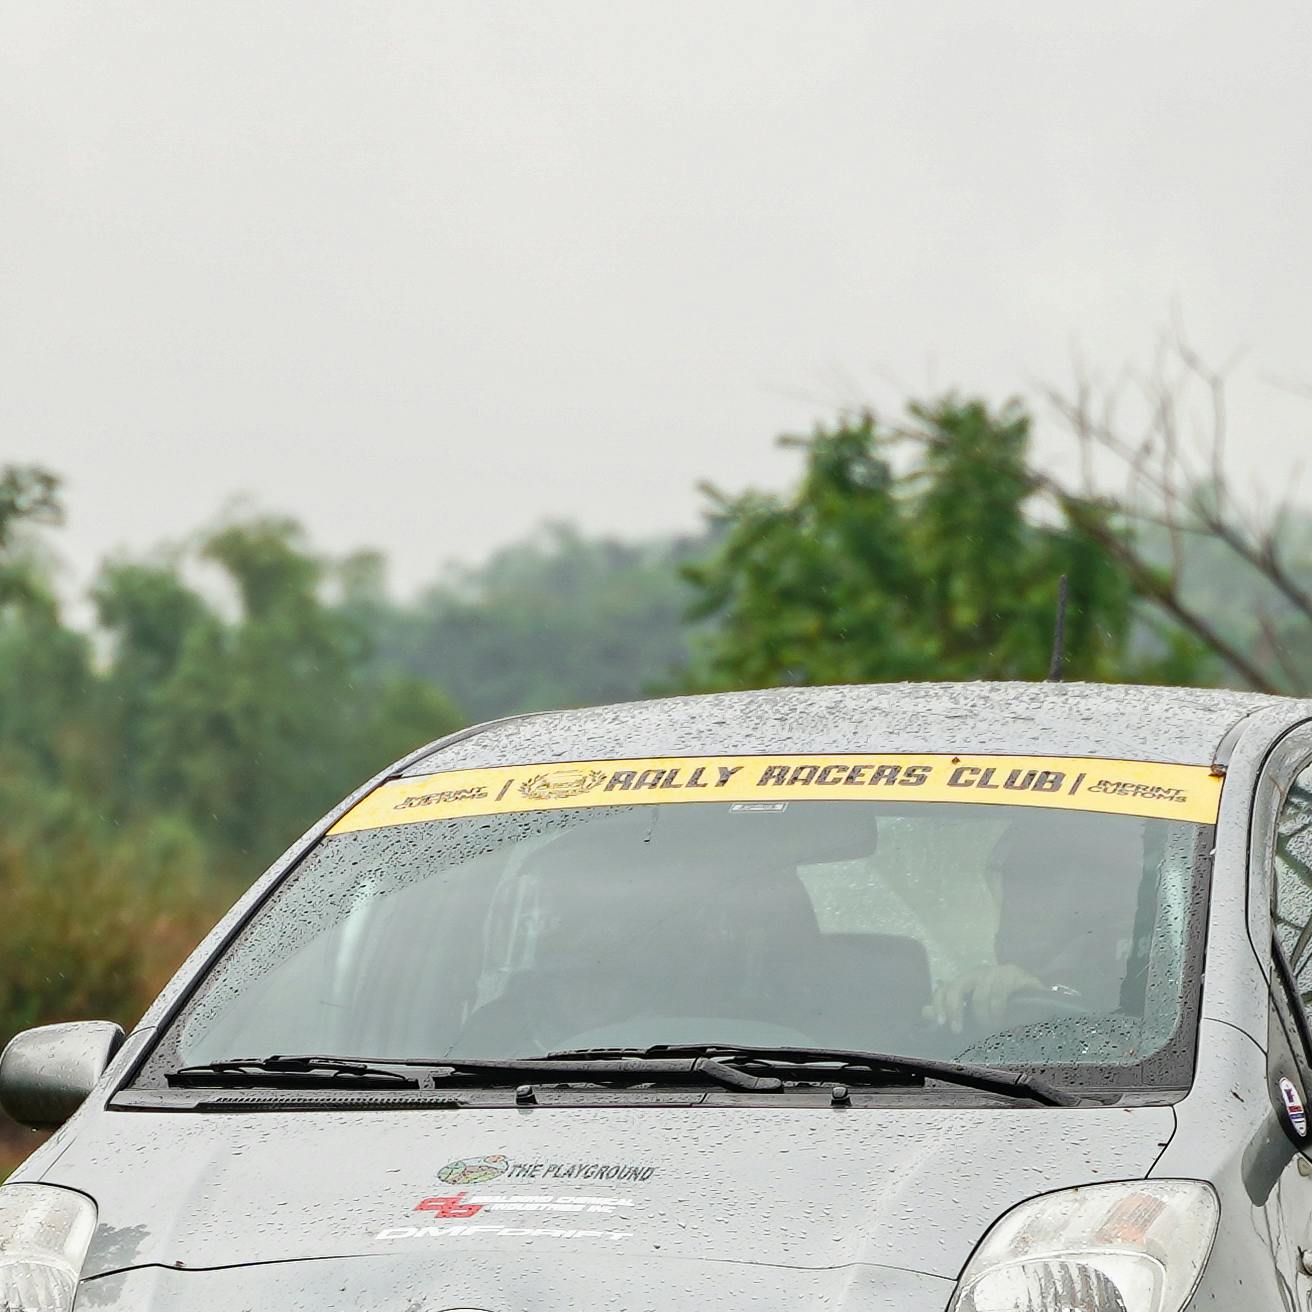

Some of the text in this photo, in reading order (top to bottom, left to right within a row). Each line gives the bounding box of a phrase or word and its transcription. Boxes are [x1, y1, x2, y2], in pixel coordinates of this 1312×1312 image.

[604, 765, 1066, 792] RALLY RACERS CLUB
[1088, 785, 1187, 802] CUSTOMS
[1097, 779, 1184, 796] IMPRINT
[507, 1164, 656, 1182] THE PLAYGROUND
